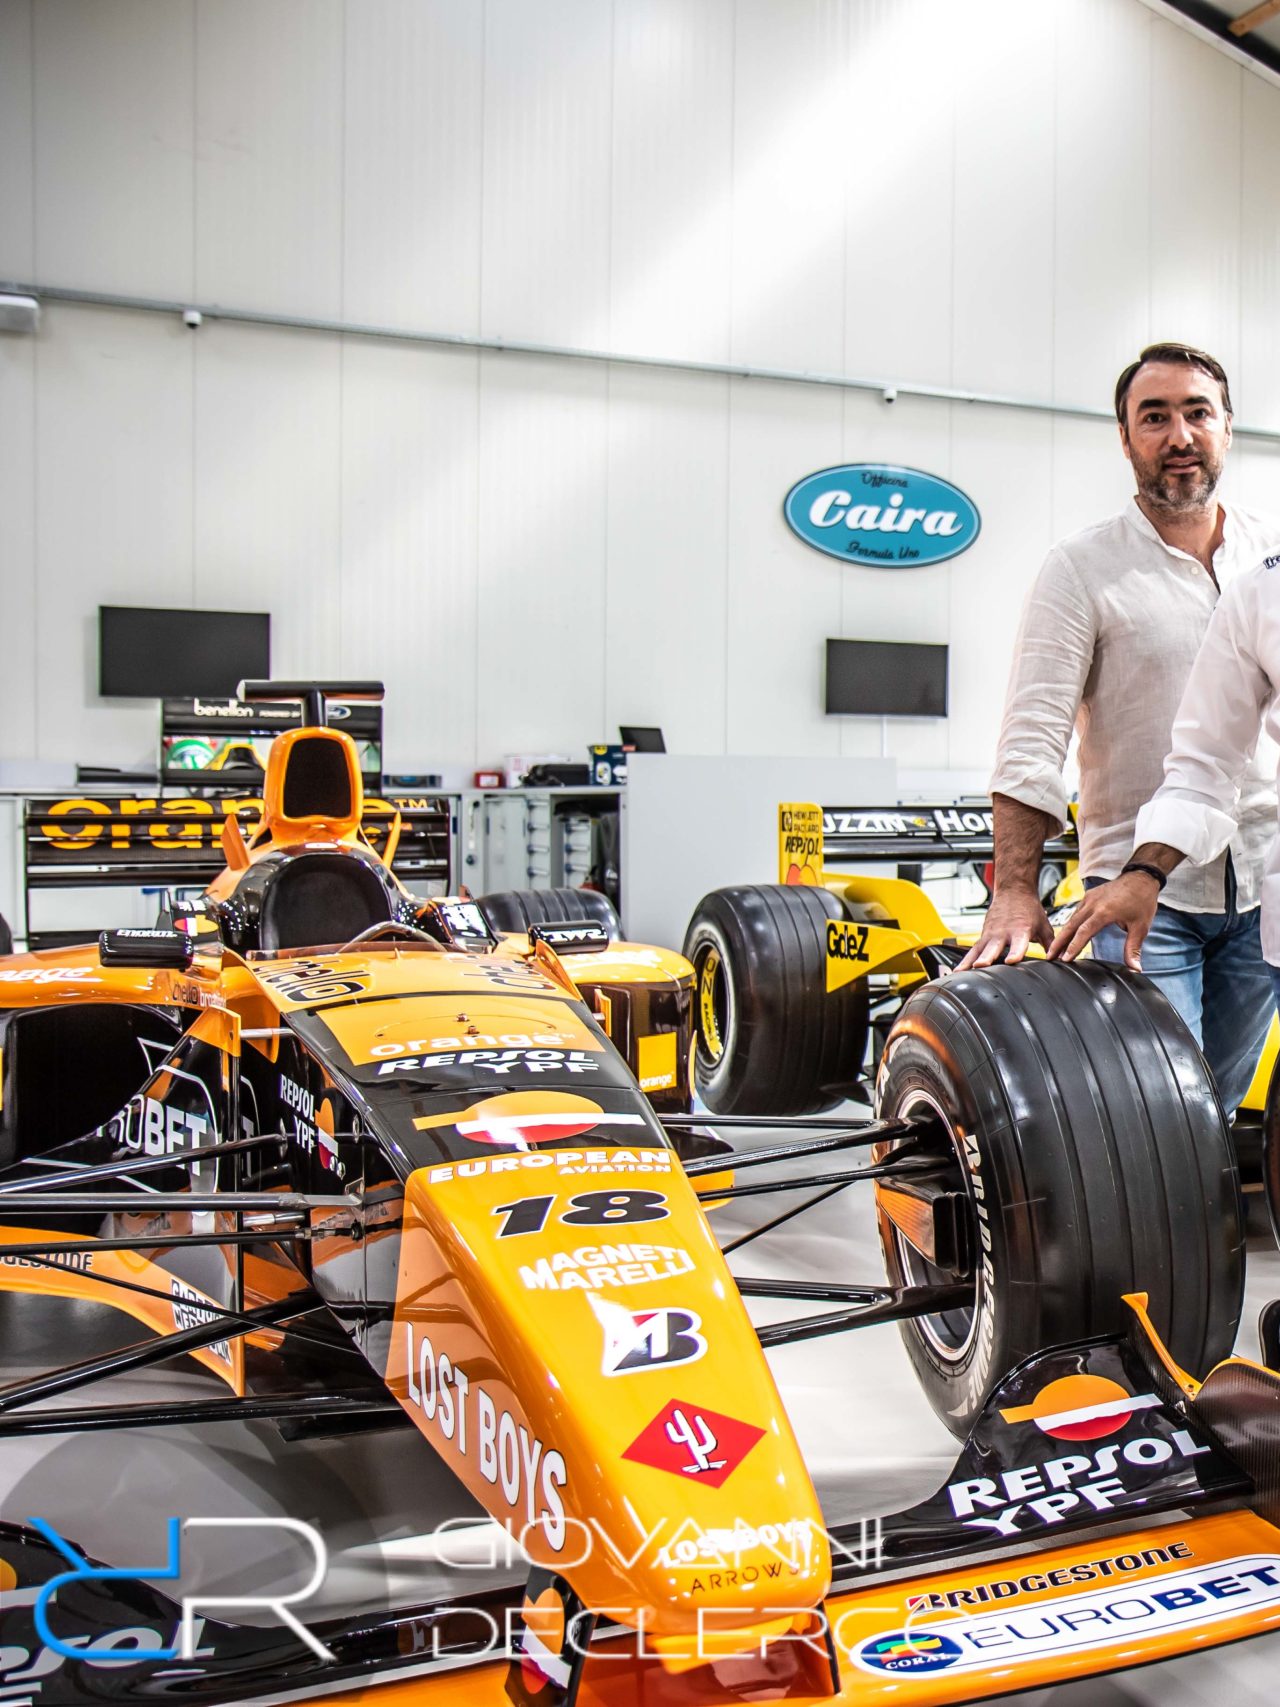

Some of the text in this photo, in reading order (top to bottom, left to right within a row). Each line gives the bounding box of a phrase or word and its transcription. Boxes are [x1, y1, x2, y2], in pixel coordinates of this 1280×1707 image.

[809, 490, 963, 537] Caira
[378, 1051, 596, 1076] REPSOL
[474, 1063, 600, 1075] YPF
[279, 1074, 315, 1123] REPSOL
[294, 1116, 316, 1154] YPF
[429, 1151, 671, 1185] EUROPEAN
[559, 1164, 672, 1176] AVIATION
[492, 1189, 671, 1239] 18
[405, 1320, 567, 1552] LOST BOYS
[947, 1428, 1211, 1519] REPSOL
[962, 1480, 1148, 1537] YPF
[905, 1541, 1195, 1616] BRIDGESTONE
[968, 1564, 1280, 1651] EUROBET
[884, 1652, 952, 1670] CORAL
